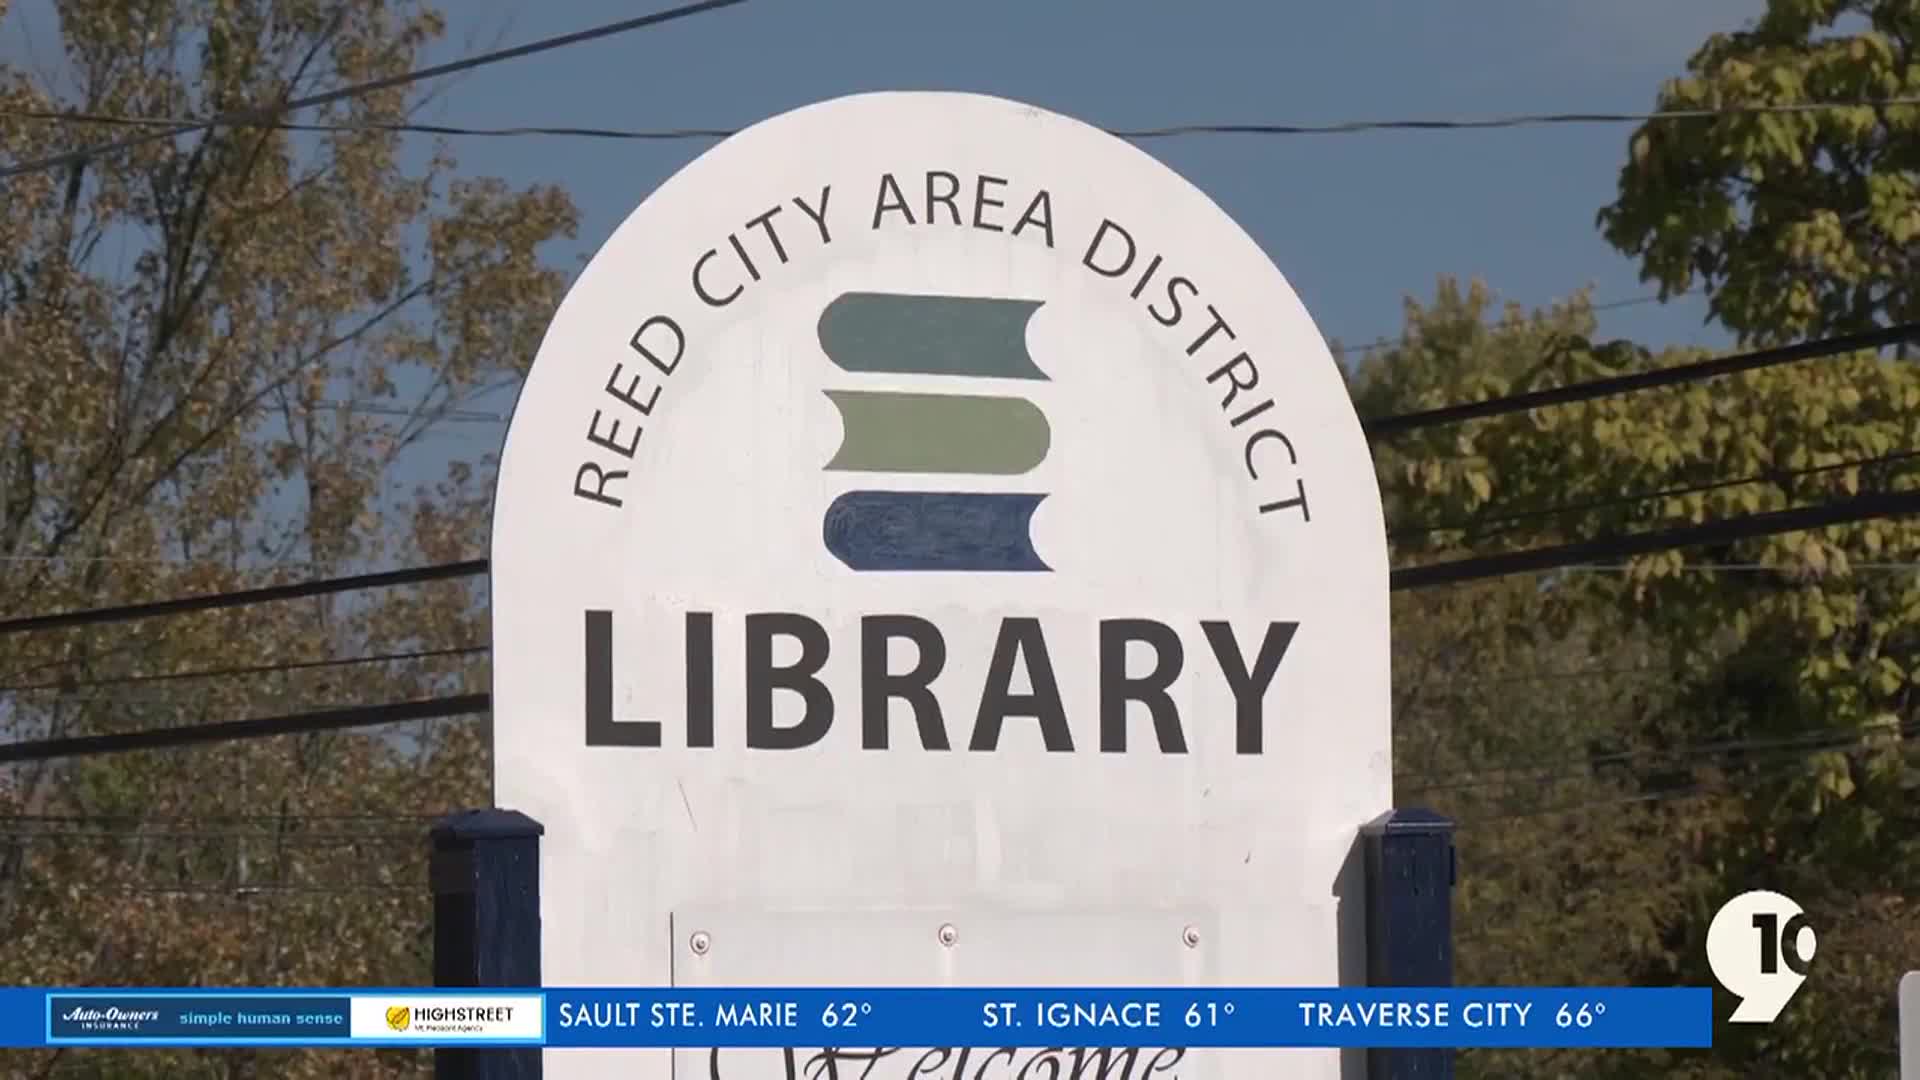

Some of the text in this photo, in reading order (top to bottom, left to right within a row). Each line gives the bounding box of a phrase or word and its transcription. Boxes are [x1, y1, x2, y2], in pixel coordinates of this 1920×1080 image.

[574, 171, 1310, 523] REED CITY AREA DISTRICT
[584, 609, 1300, 755] LIBRARY
